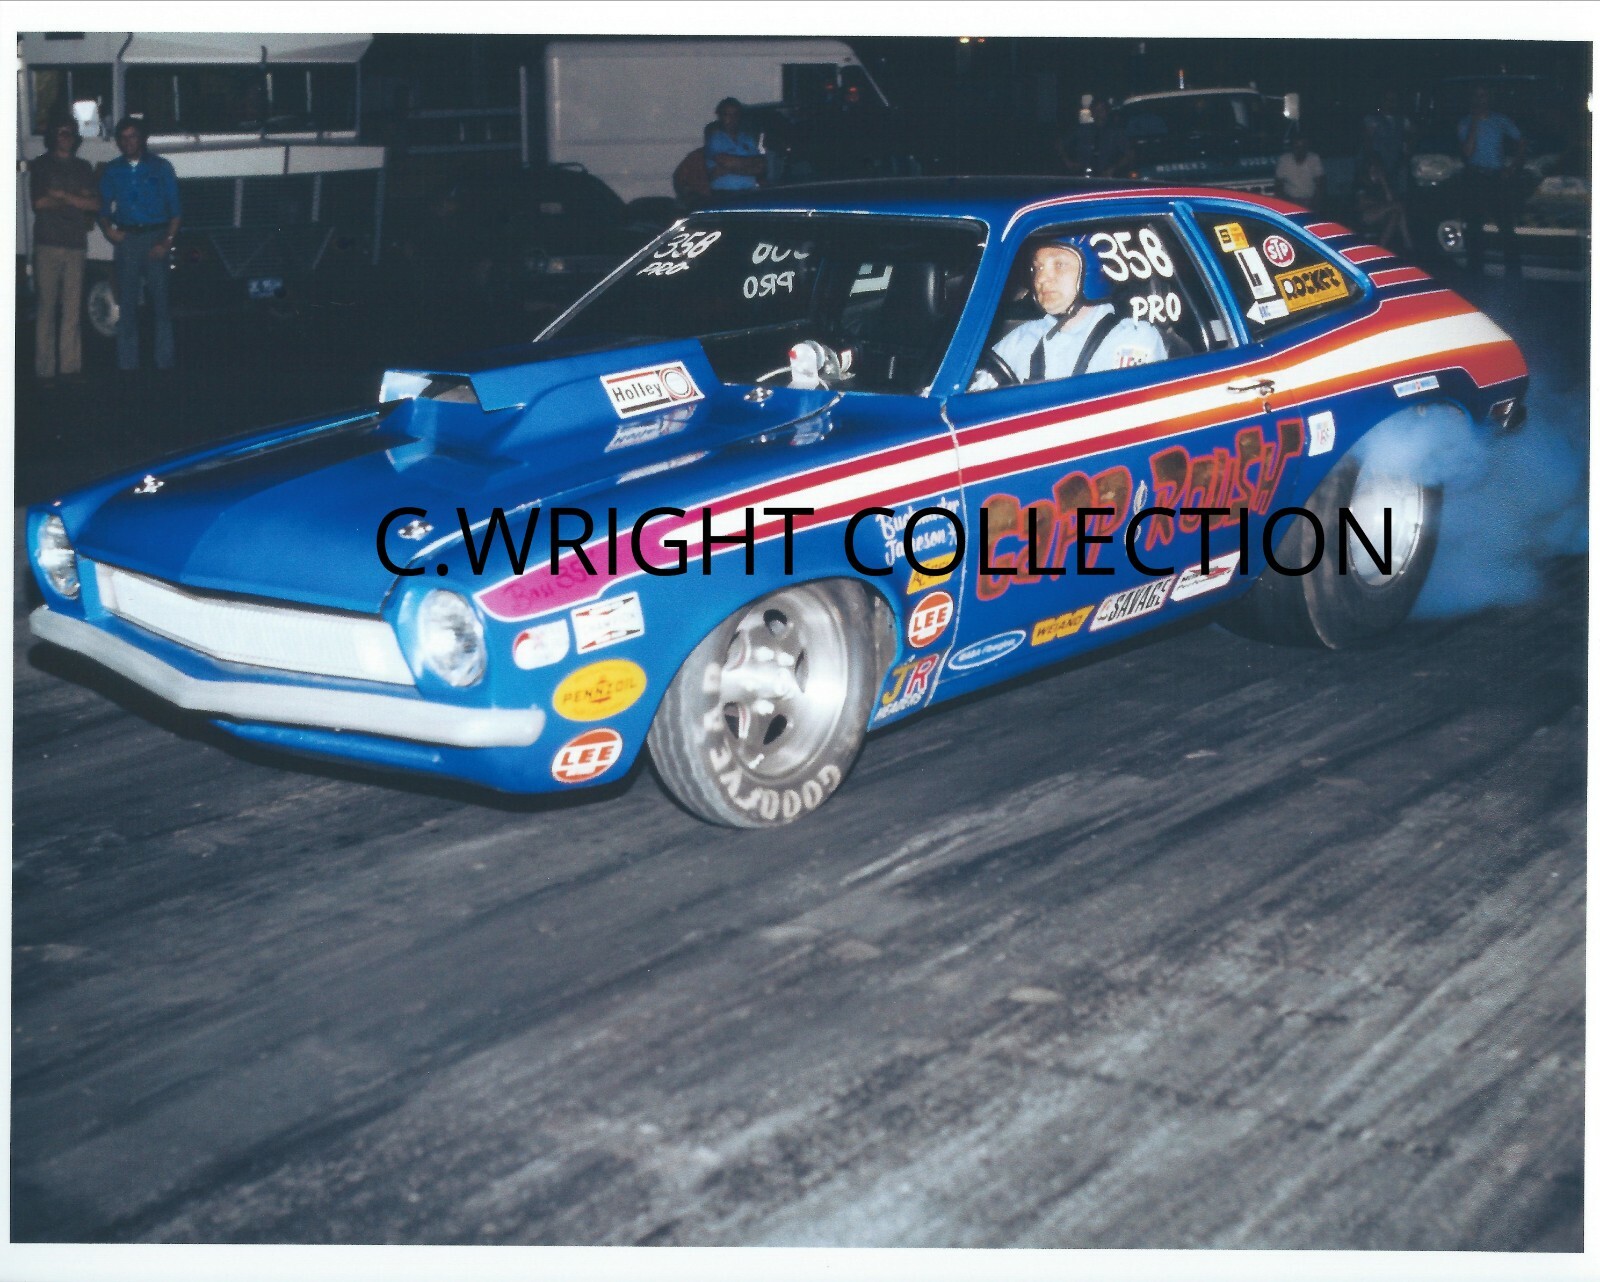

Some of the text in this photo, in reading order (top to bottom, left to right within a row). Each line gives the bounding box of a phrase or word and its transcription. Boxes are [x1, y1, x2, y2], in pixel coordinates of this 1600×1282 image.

[653, 230, 722, 259] 358
[1089, 228, 1174, 281] 358
[1267, 239, 1289, 260] STP
[1281, 267, 1341, 300] ROCKET
[1129, 292, 1181, 325] PRO
[611, 377, 664, 403] Holley
[1107, 578, 1172, 622] SAVAGE
[912, 605, 948, 632] LEE
[562, 677, 638, 705] PENNZOIL
[882, 653, 940, 706] JR
[560, 744, 616, 767] LEE
